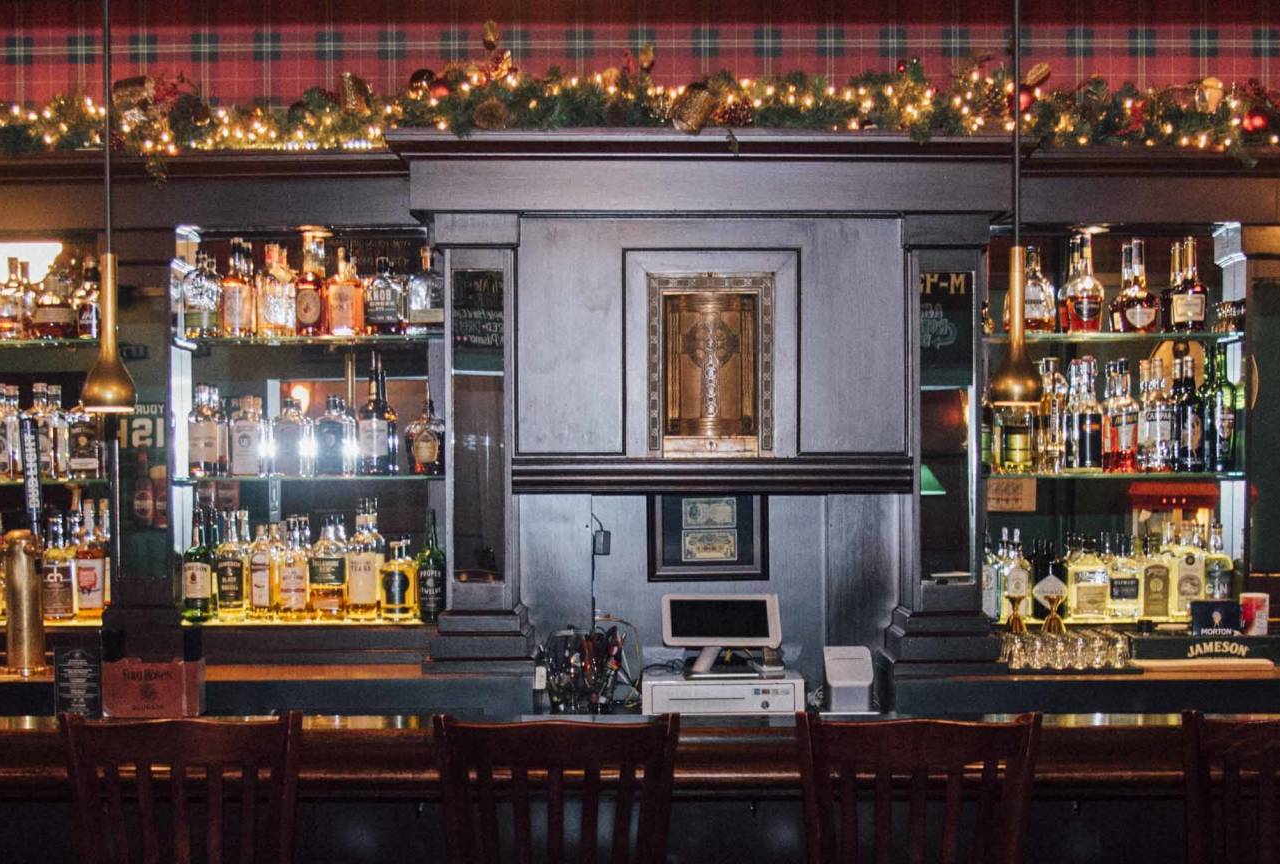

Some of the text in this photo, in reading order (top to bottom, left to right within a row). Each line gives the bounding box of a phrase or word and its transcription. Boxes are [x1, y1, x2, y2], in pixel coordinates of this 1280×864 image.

[1205, 583, 1228, 594] GIN
[1200, 627, 1232, 636] MORTON
[1187, 640, 1248, 657] JAMESON
